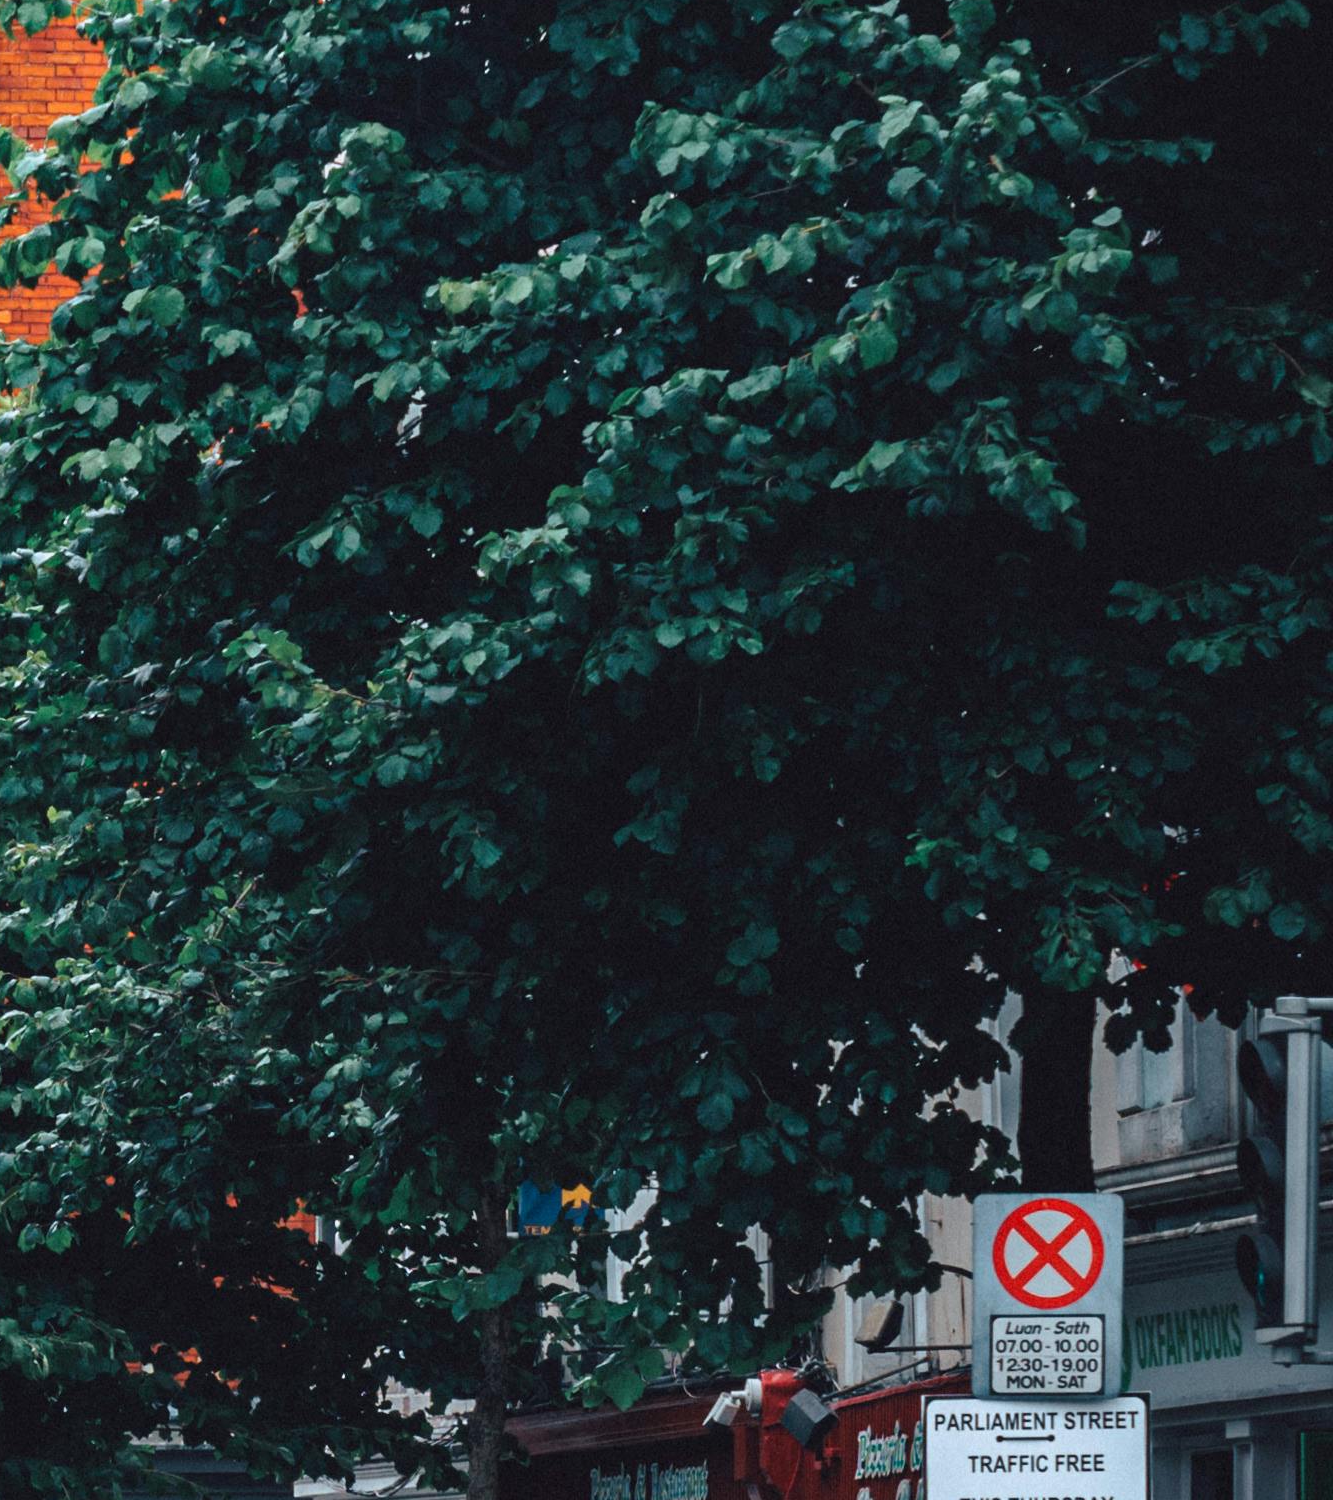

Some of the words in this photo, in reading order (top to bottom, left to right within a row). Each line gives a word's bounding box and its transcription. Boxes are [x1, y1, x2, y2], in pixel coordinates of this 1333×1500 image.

[1005, 1321, 1042, 1335] Luan
[1053, 1321, 1090, 1335] Sath
[1007, 1376, 1045, 1389] MON
[1058, 1375, 1087, 1388] SAT
[934, 1412, 1058, 1431] PARLIAMENT
[1064, 1411, 1139, 1430] STREET
[968, 1454, 1049, 1473] TRAFFIC
[1055, 1454, 1105, 1472] FREE
